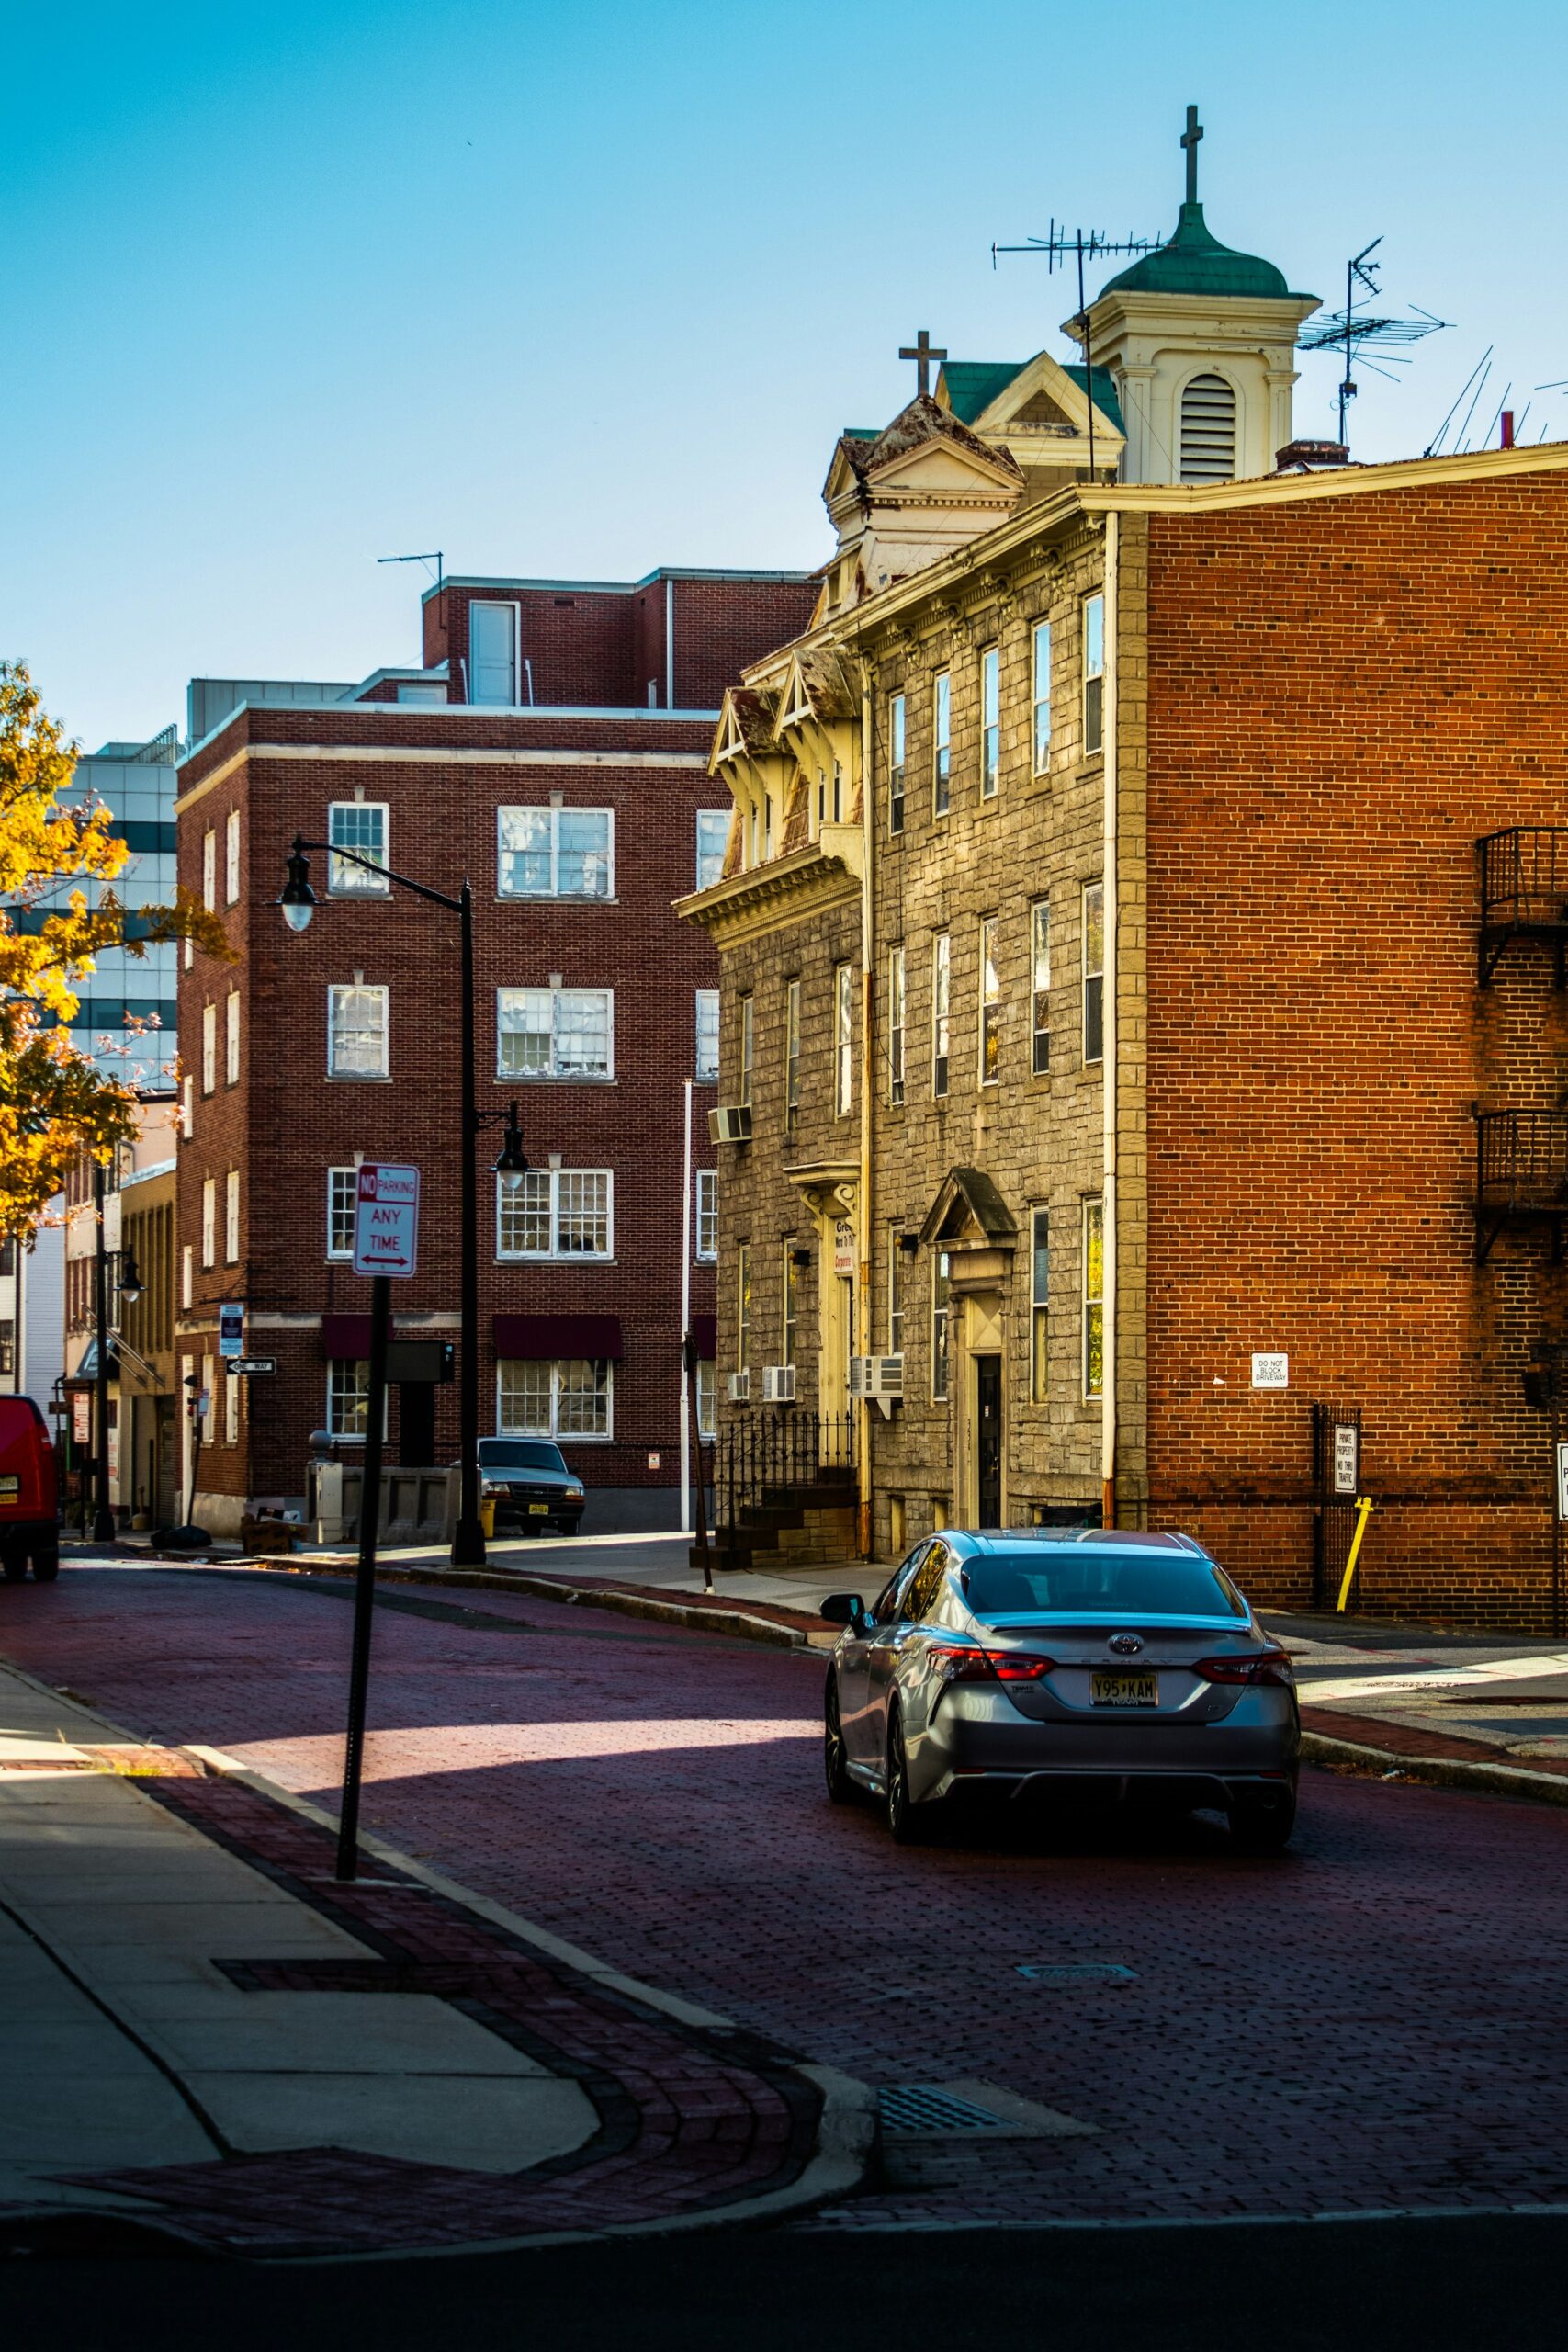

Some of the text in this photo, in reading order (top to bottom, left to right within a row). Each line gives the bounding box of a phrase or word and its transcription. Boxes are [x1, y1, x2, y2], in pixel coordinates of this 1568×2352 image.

[361, 1174, 414, 1194] NO PARKING
[371, 1208, 401, 1225] ANY
[836, 1221, 852, 1232] Gre
[370, 1234, 401, 1251] TIME
[1338, 1433, 1352, 1444] PRIVATE
[1337, 1445, 1354, 1456] PROPERTY
[1337, 1460, 1343, 1471] NO
[1338, 1472, 1352, 1484] TRAFFIC
